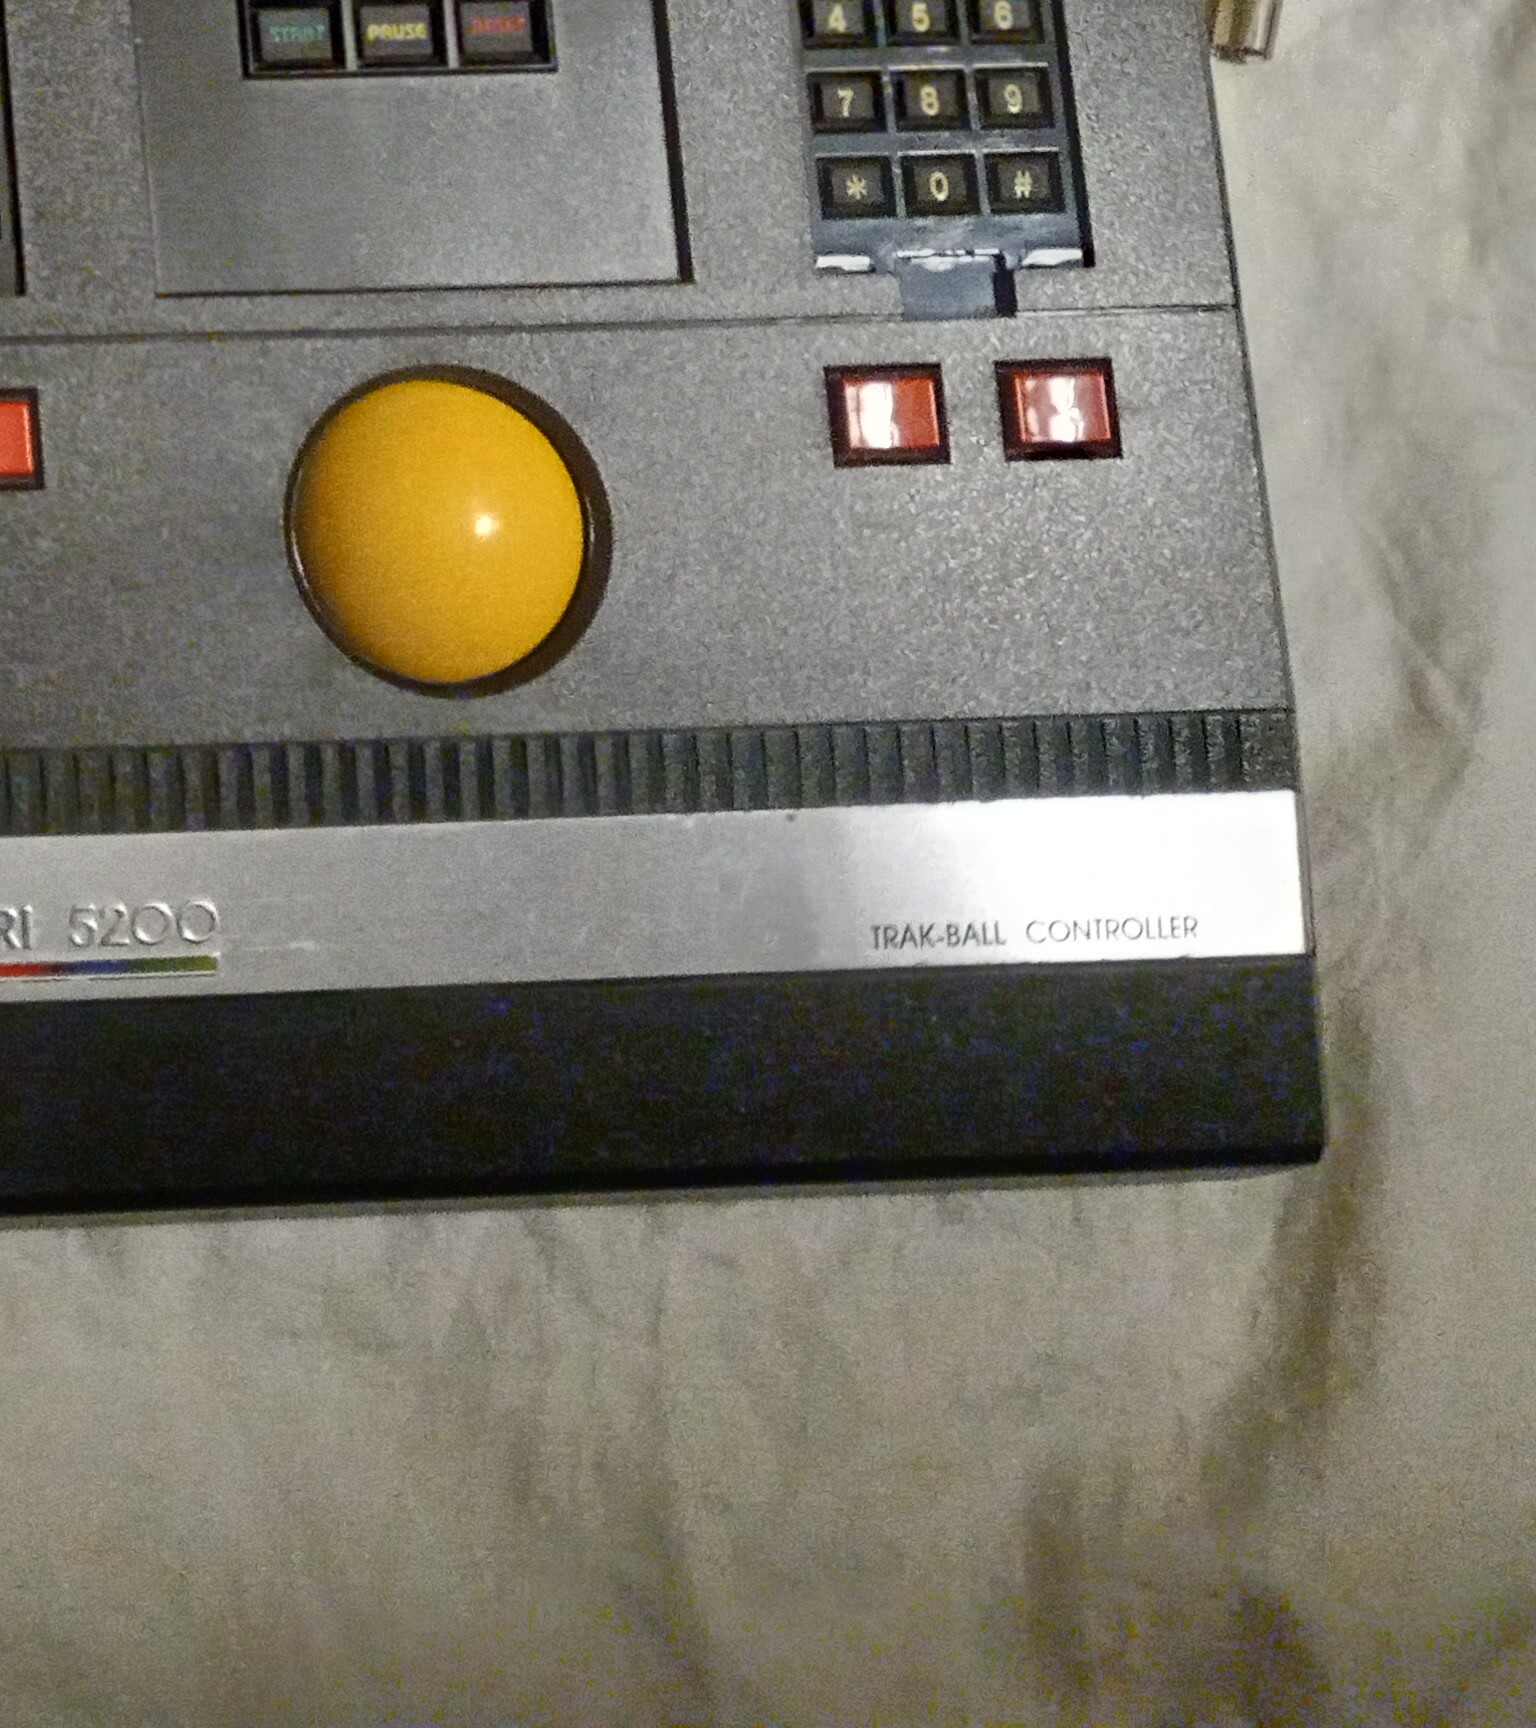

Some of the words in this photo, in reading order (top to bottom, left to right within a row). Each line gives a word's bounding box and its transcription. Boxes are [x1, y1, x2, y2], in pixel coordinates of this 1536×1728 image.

[365, 23, 427, 41] PAUSE
[825, 2, 848, 34] 4
[910, 1, 932, 32] 5
[836, 87, 855, 118] 7
[918, 84, 941, 116] 8
[1003, 83, 1023, 114] 9
[928, 170, 949, 201] 0
[68, 899, 220, 949] 5200
[870, 919, 1008, 951] TRAK-BALL
[1025, 915, 1200, 945] CONTROLLER
